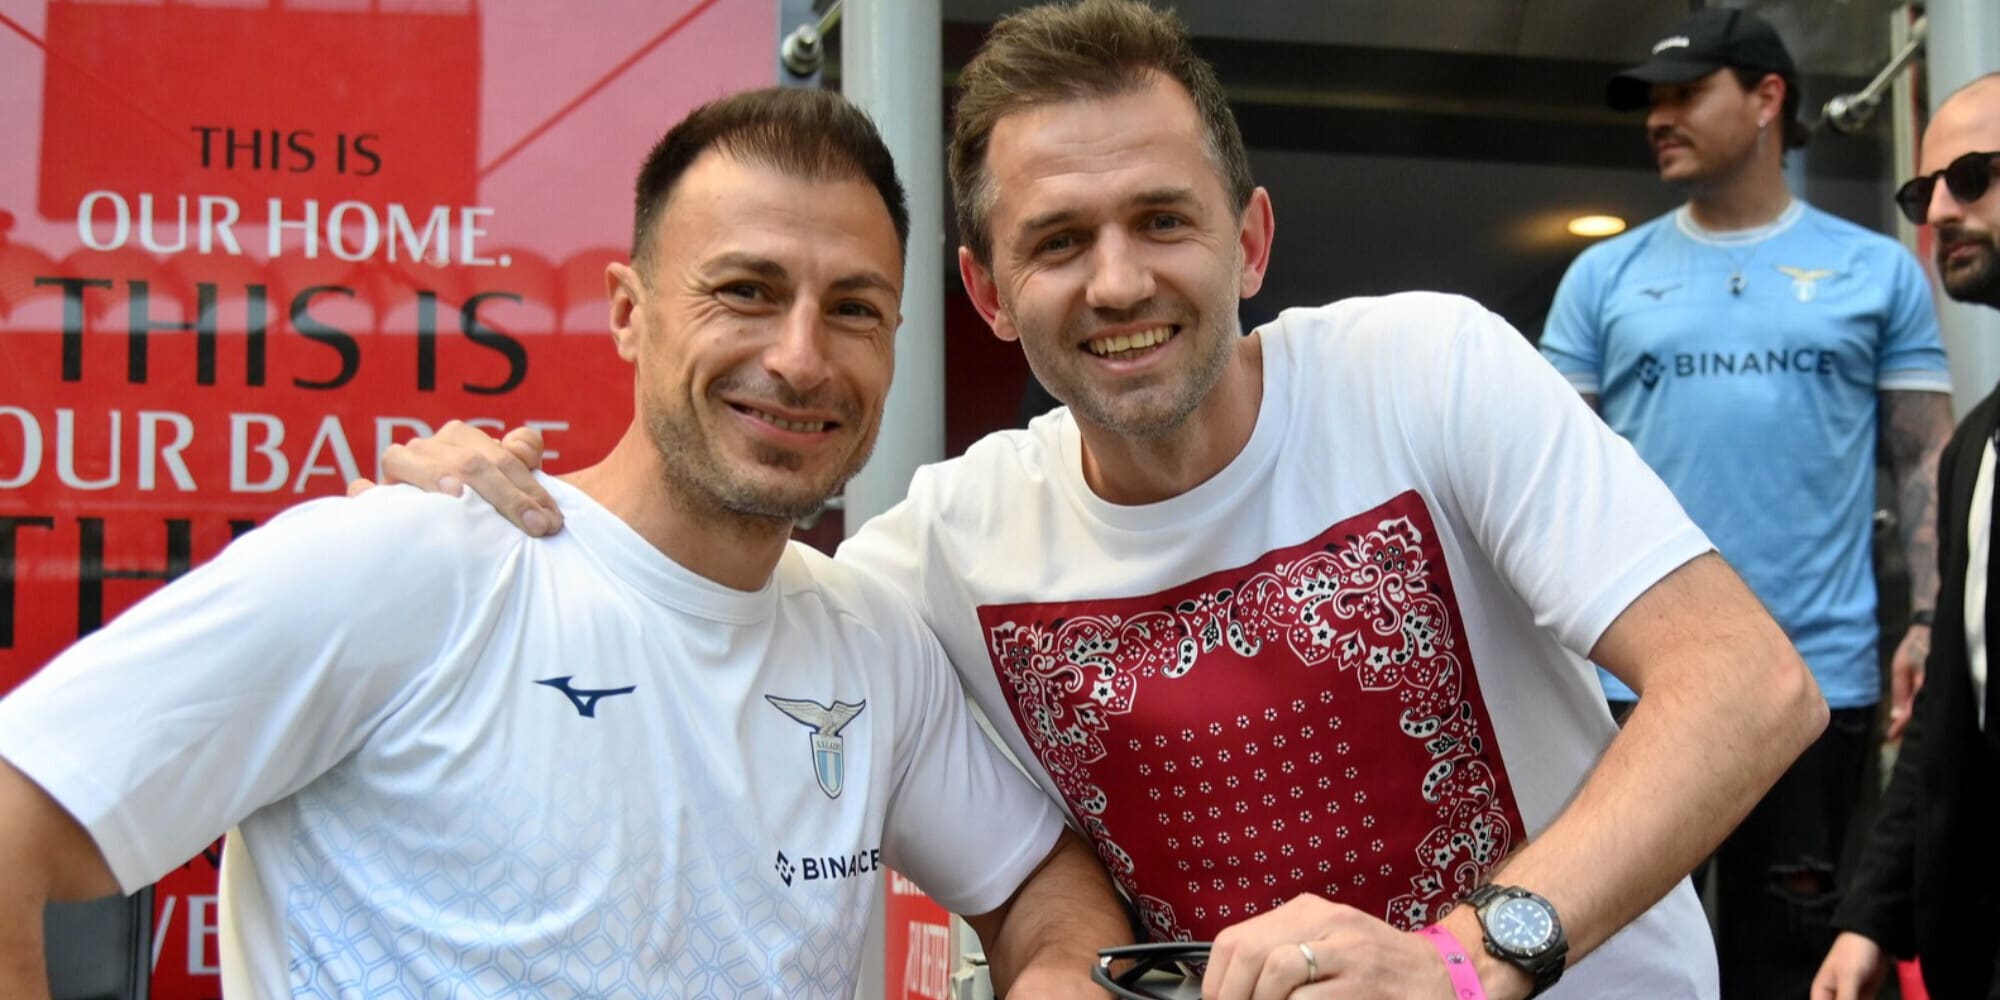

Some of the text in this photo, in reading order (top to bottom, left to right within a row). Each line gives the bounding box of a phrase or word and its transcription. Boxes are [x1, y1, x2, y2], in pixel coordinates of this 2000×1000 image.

[191, 126, 381, 177] THIS IS
[77, 190, 512, 268] OUR HOME.
[34, 277, 528, 396] THIS IS
[1674, 349, 1837, 378] BINANCE
[0, 407, 197, 492] OUR
[802, 848, 880, 881] BINACE
